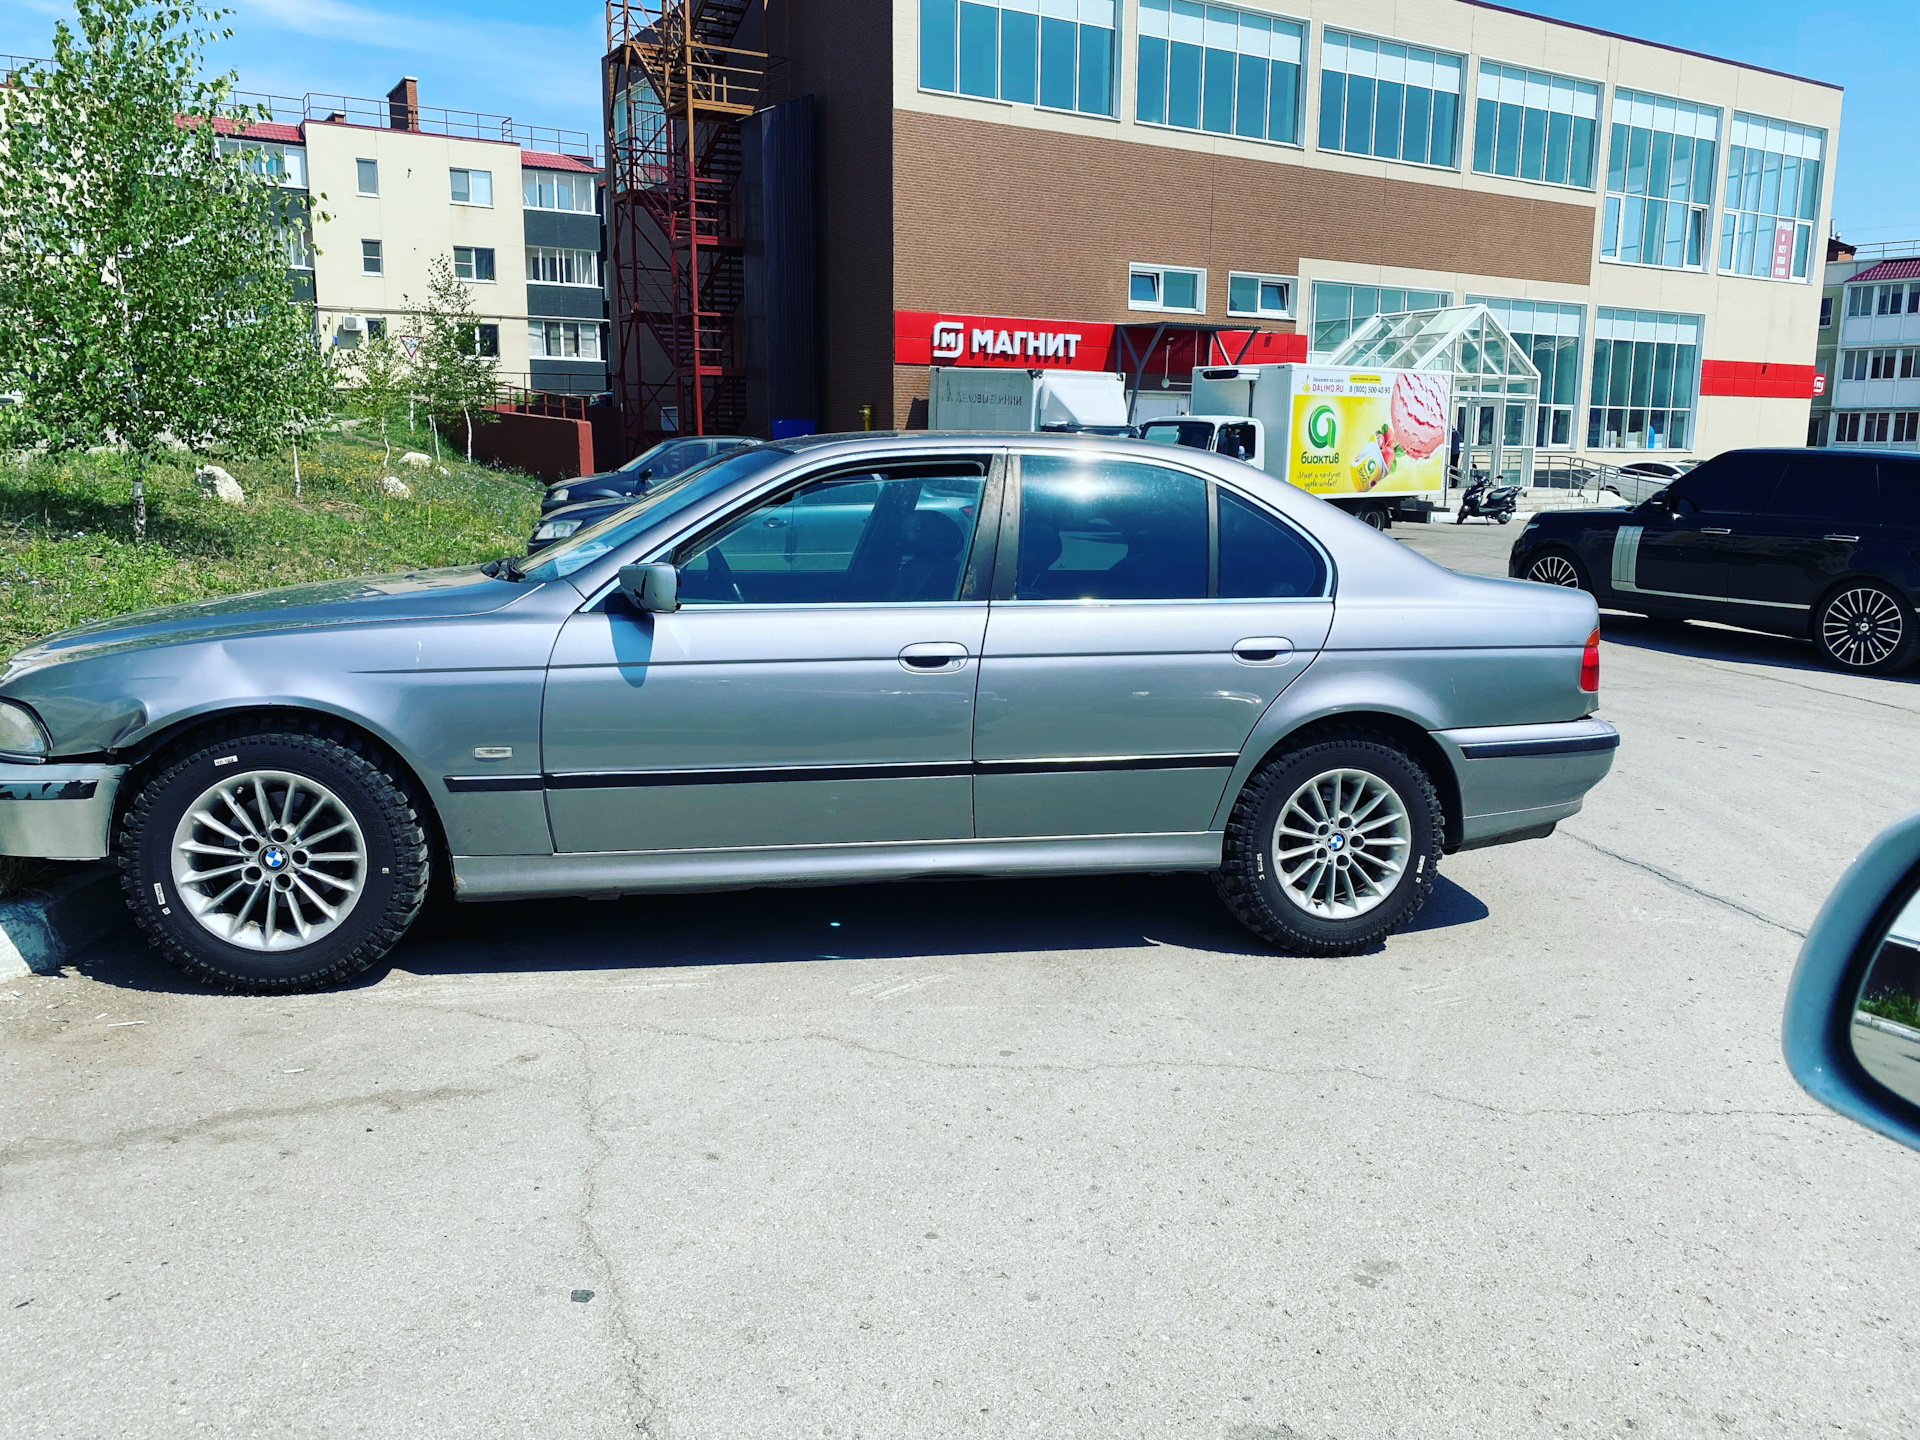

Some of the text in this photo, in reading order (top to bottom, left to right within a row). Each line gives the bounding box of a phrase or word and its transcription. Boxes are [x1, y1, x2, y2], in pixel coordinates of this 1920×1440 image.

[971, 328, 1081, 357] МАГНИТ
[1312, 383, 1344, 393] DALIMO.RU
[1354, 385, 1367, 395] (800)
[1368, 386, 1377, 394] 500
[1301, 451, 1340, 464] биактив
